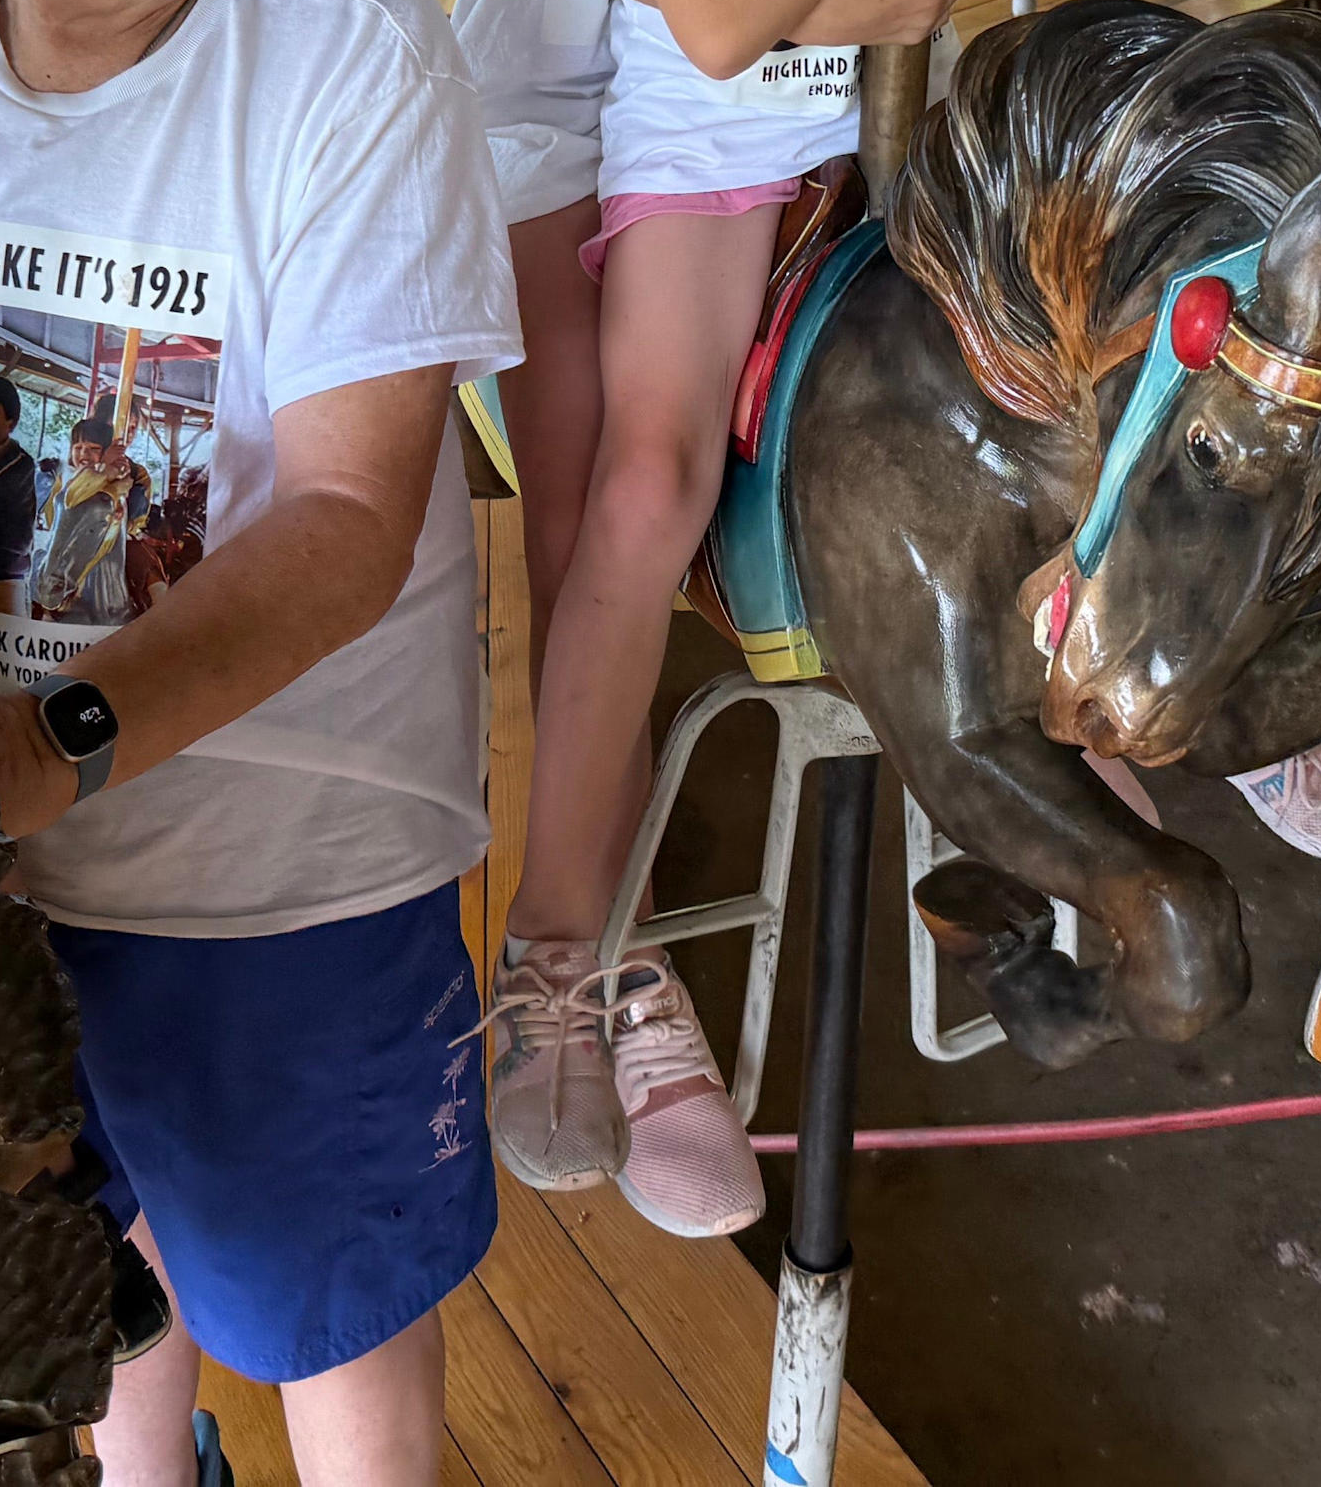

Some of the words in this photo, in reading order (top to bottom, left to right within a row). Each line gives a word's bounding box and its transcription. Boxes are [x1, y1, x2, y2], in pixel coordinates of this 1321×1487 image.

[762, 57, 848, 83] HIGHLAND
[56, 251, 117, 304] IT'S
[130, 263, 209, 316] 1925
[14, 664, 48, 684] YOR
